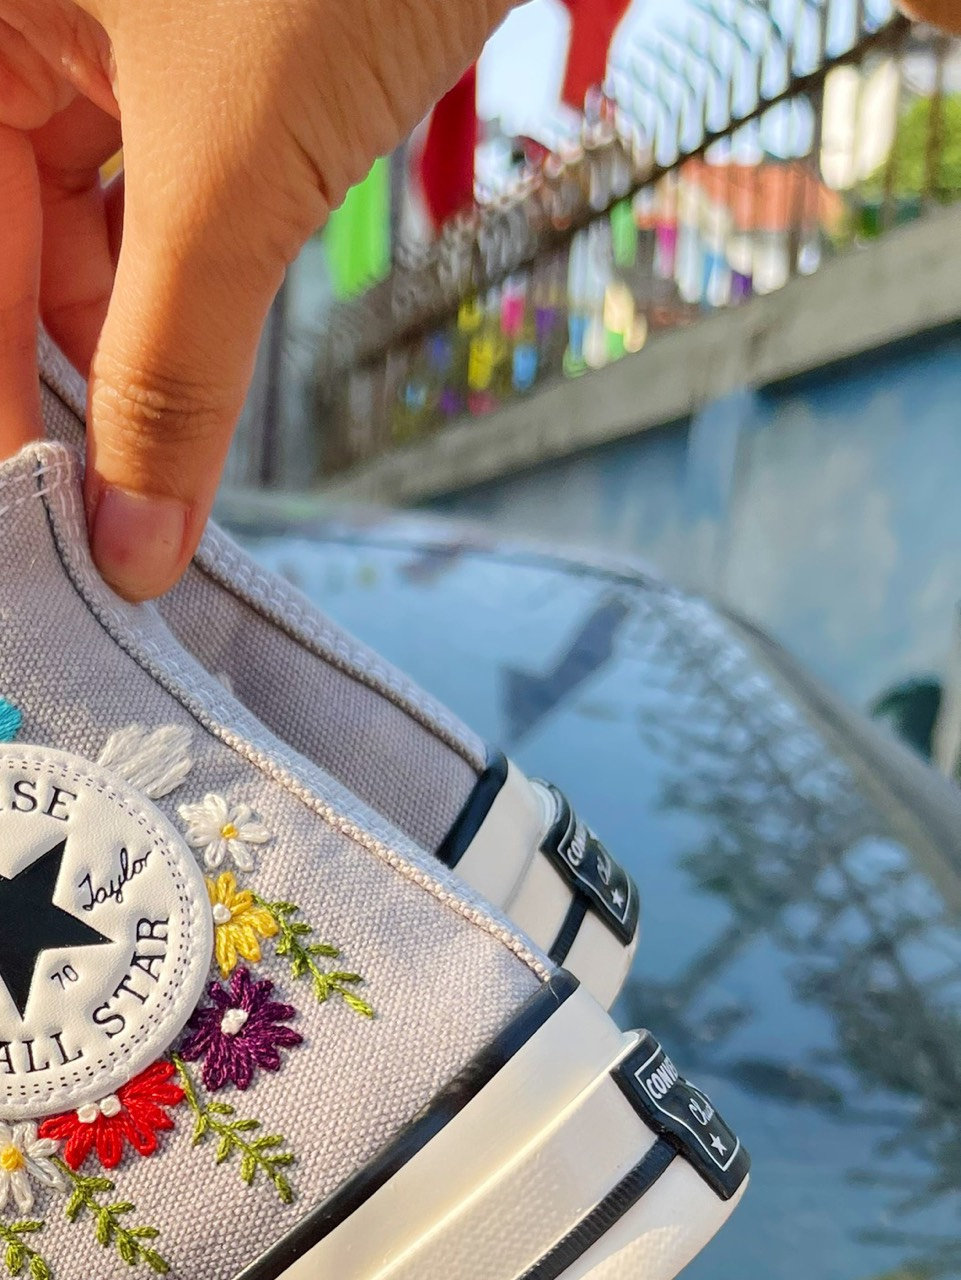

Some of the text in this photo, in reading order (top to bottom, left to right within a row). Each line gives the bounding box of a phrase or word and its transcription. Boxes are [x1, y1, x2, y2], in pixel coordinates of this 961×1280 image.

[78, 847, 151, 911] Taylor
[50, 964, 79, 991] 70
[92, 916, 170, 1039] STAR
